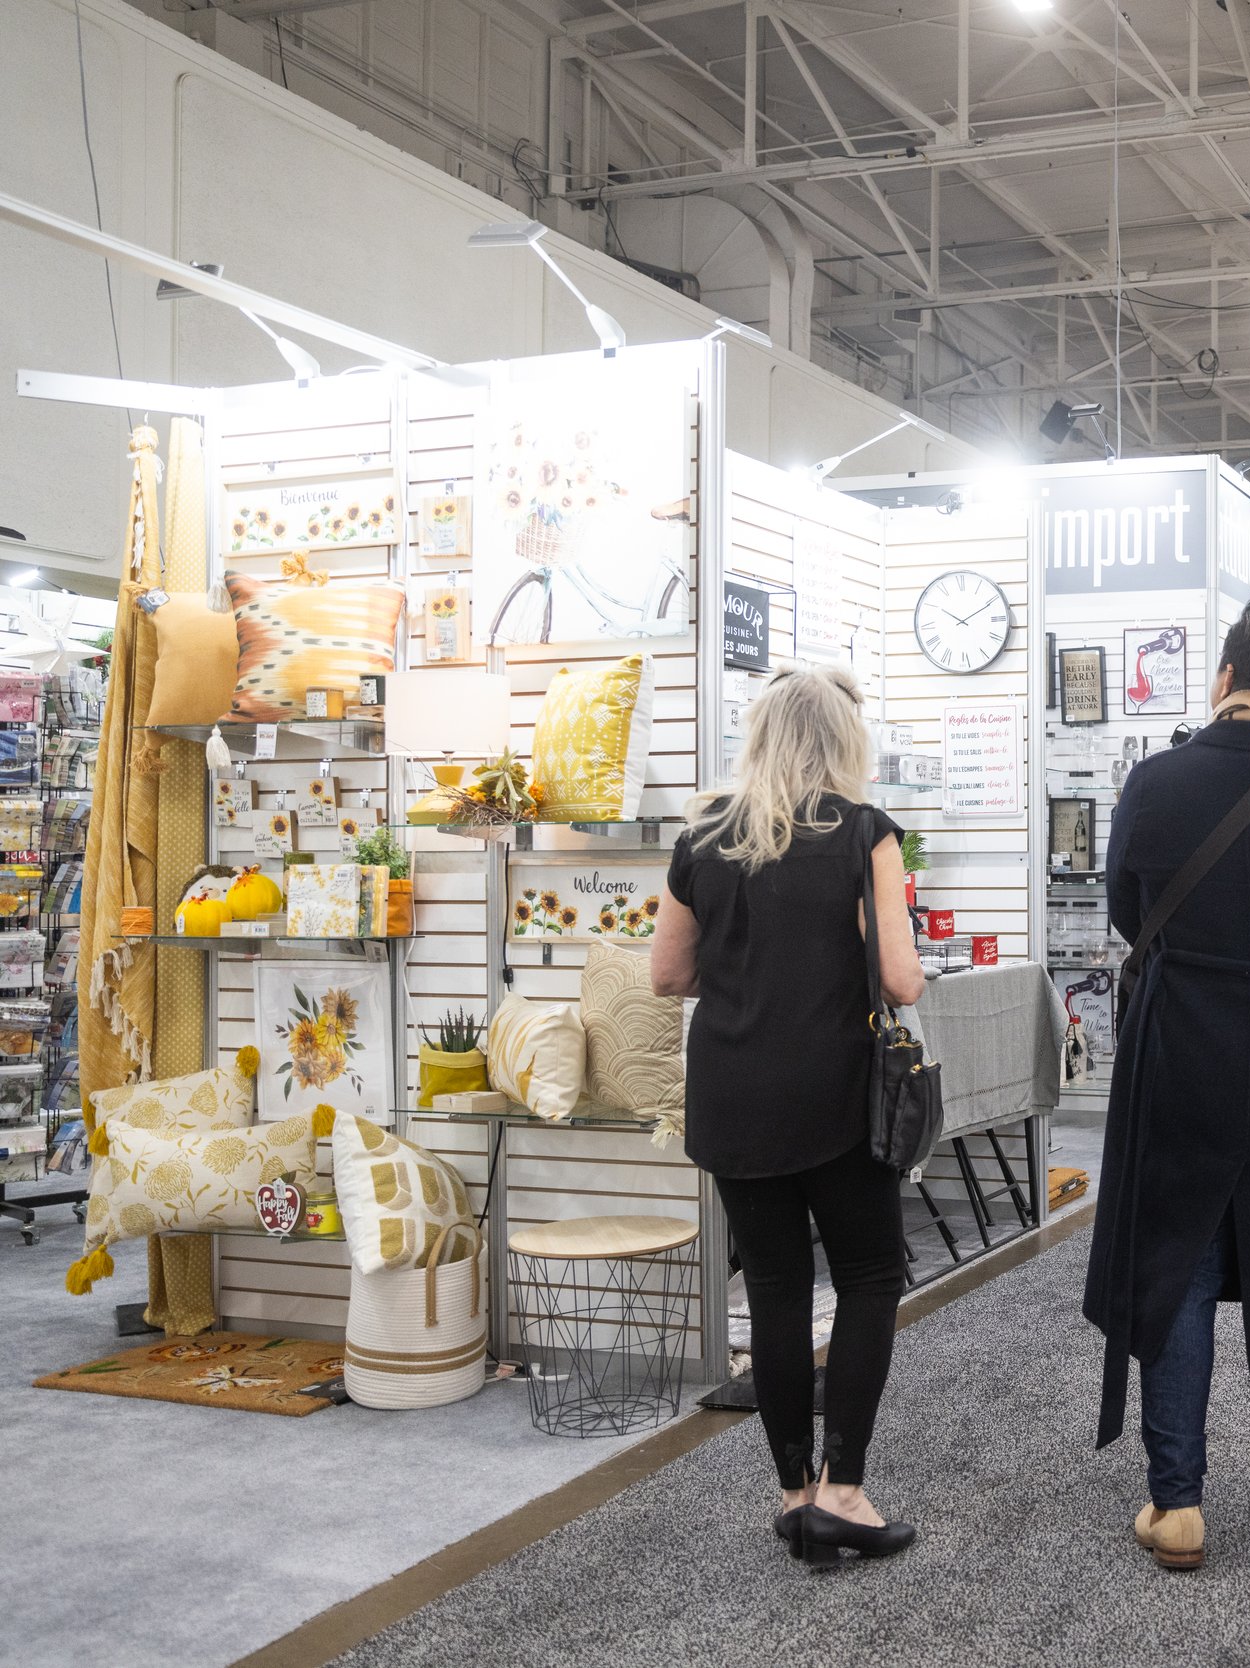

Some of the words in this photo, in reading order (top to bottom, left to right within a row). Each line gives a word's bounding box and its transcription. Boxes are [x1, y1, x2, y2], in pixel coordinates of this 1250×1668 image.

[736, 643, 758, 656] JOURS
[1066, 664, 1096, 673] RETIRE
[1066, 672, 1096, 681] EARLY
[1068, 695, 1098, 704] DRINK
[574, 871, 638, 894] Welcome
[1080, 998, 1102, 1012] Time
[1084, 1019, 1111, 1032] Wine
[258, 1196, 289, 1212] Happy
[275, 1206, 295, 1224] Fall
